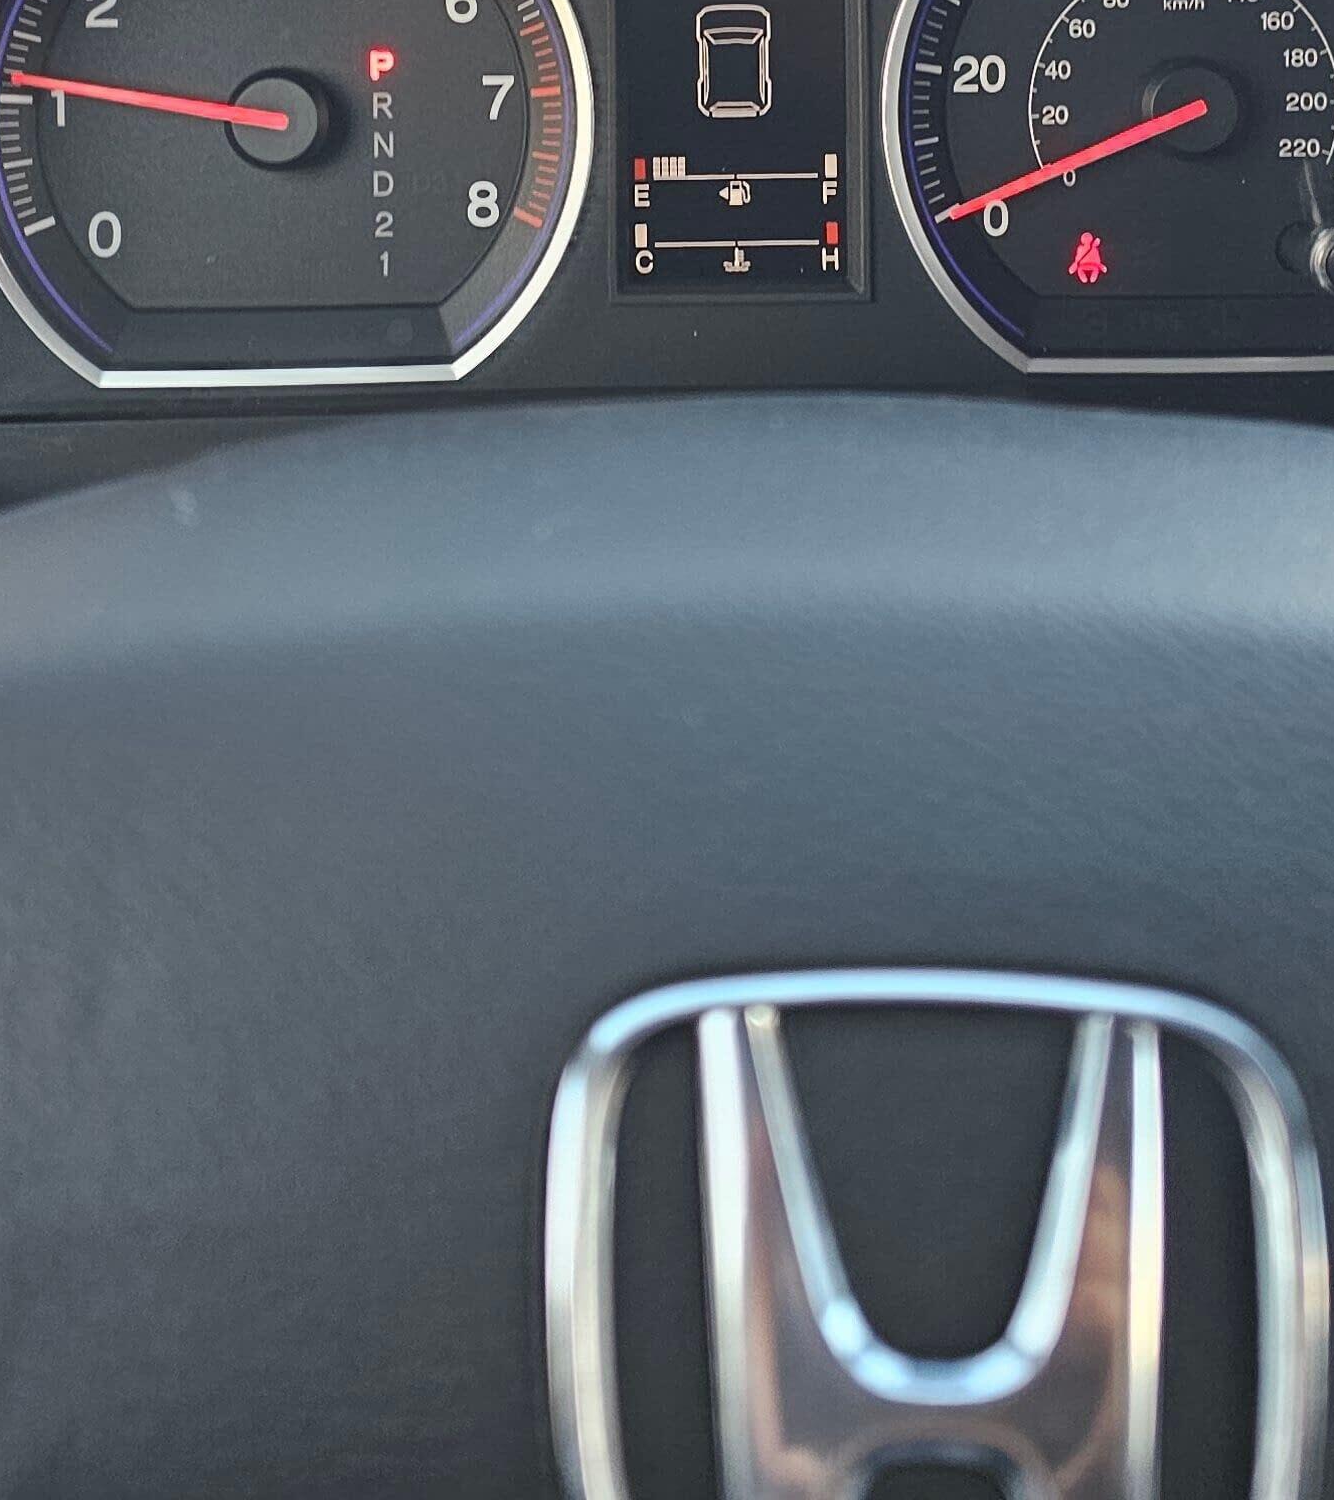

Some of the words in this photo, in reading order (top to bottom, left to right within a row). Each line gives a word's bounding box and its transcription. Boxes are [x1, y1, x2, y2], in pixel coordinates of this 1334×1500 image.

[1068, 18, 1096, 39] 60
[1260, 10, 1295, 31] 160
[370, 51, 395, 80] P
[1044, 59, 1072, 80] 40
[1283, 47, 1318, 68] 180
[953, 54, 1006, 94] 20
[372, 91, 393, 119] R
[482, 74, 515, 121] 7
[1285, 91, 1328, 112] 200
[1042, 105, 1069, 125] 20
[373, 130, 394, 158] N
[1278, 138, 1321, 159] 220
[373, 170, 394, 198] D
[634, 183, 651, 208] E
[822, 180, 838, 205] F
[467, 180, 500, 228] 8
[374, 210, 394, 238] 2
[982, 202, 1009, 237] 0
[88, 210, 122, 258] 0
[379, 250, 389, 277] 1
[635, 250, 654, 274] C
[821, 247, 840, 271] H
